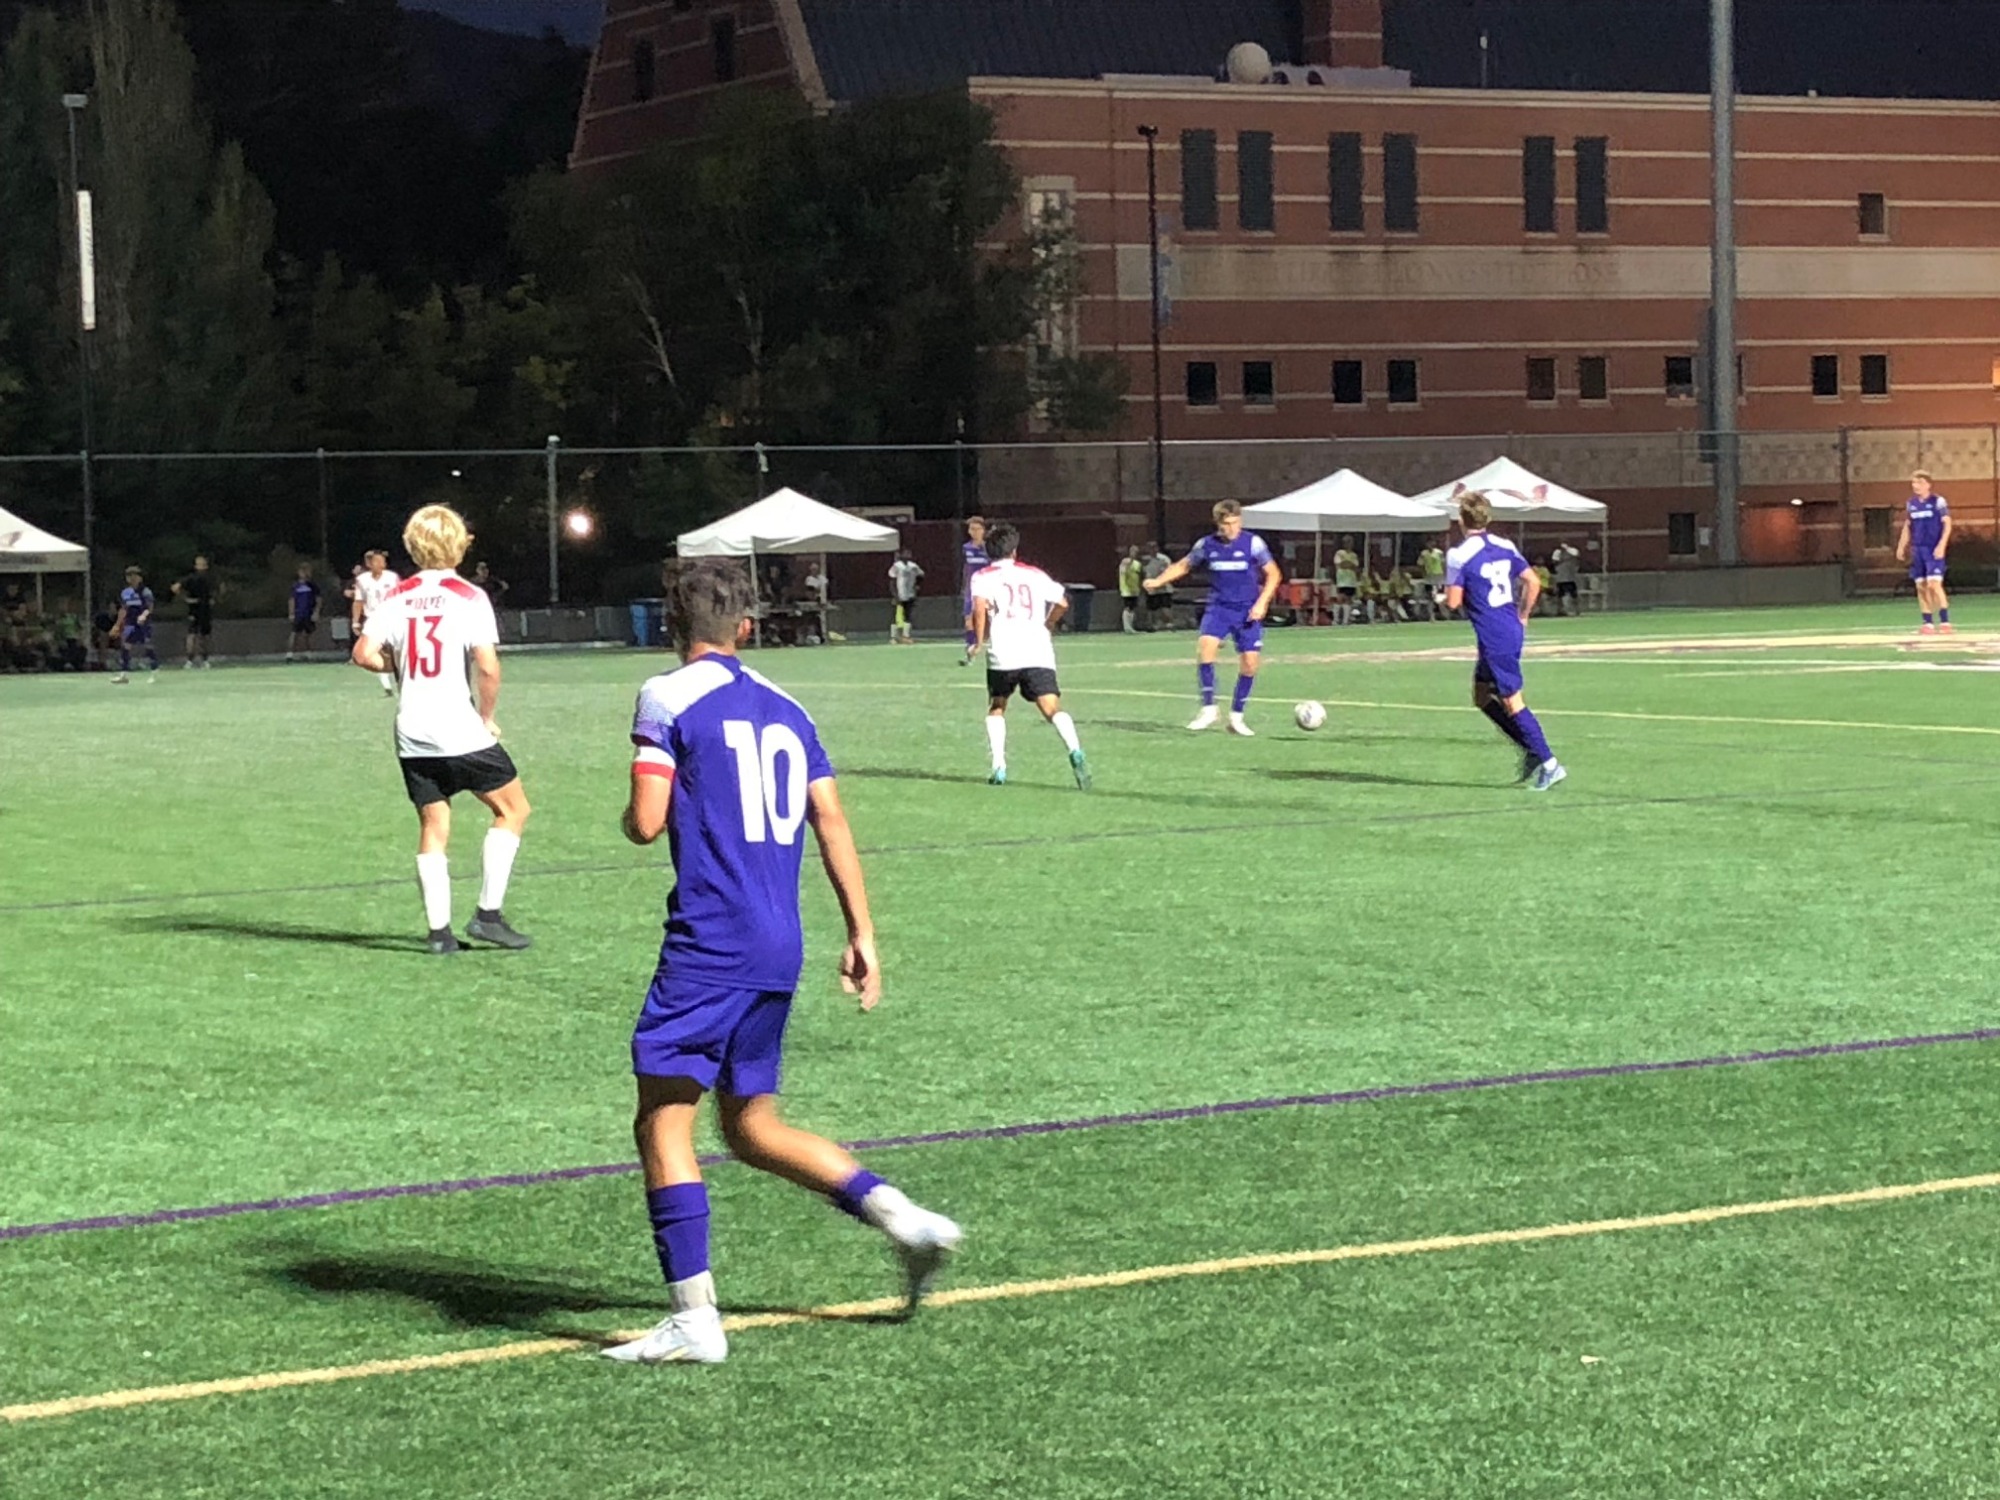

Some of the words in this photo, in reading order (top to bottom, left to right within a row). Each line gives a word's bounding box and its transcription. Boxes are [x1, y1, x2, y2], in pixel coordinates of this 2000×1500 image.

[1002, 582, 1033, 620] 29
[406, 615, 443, 680] 13
[722, 719, 808, 845] 10
